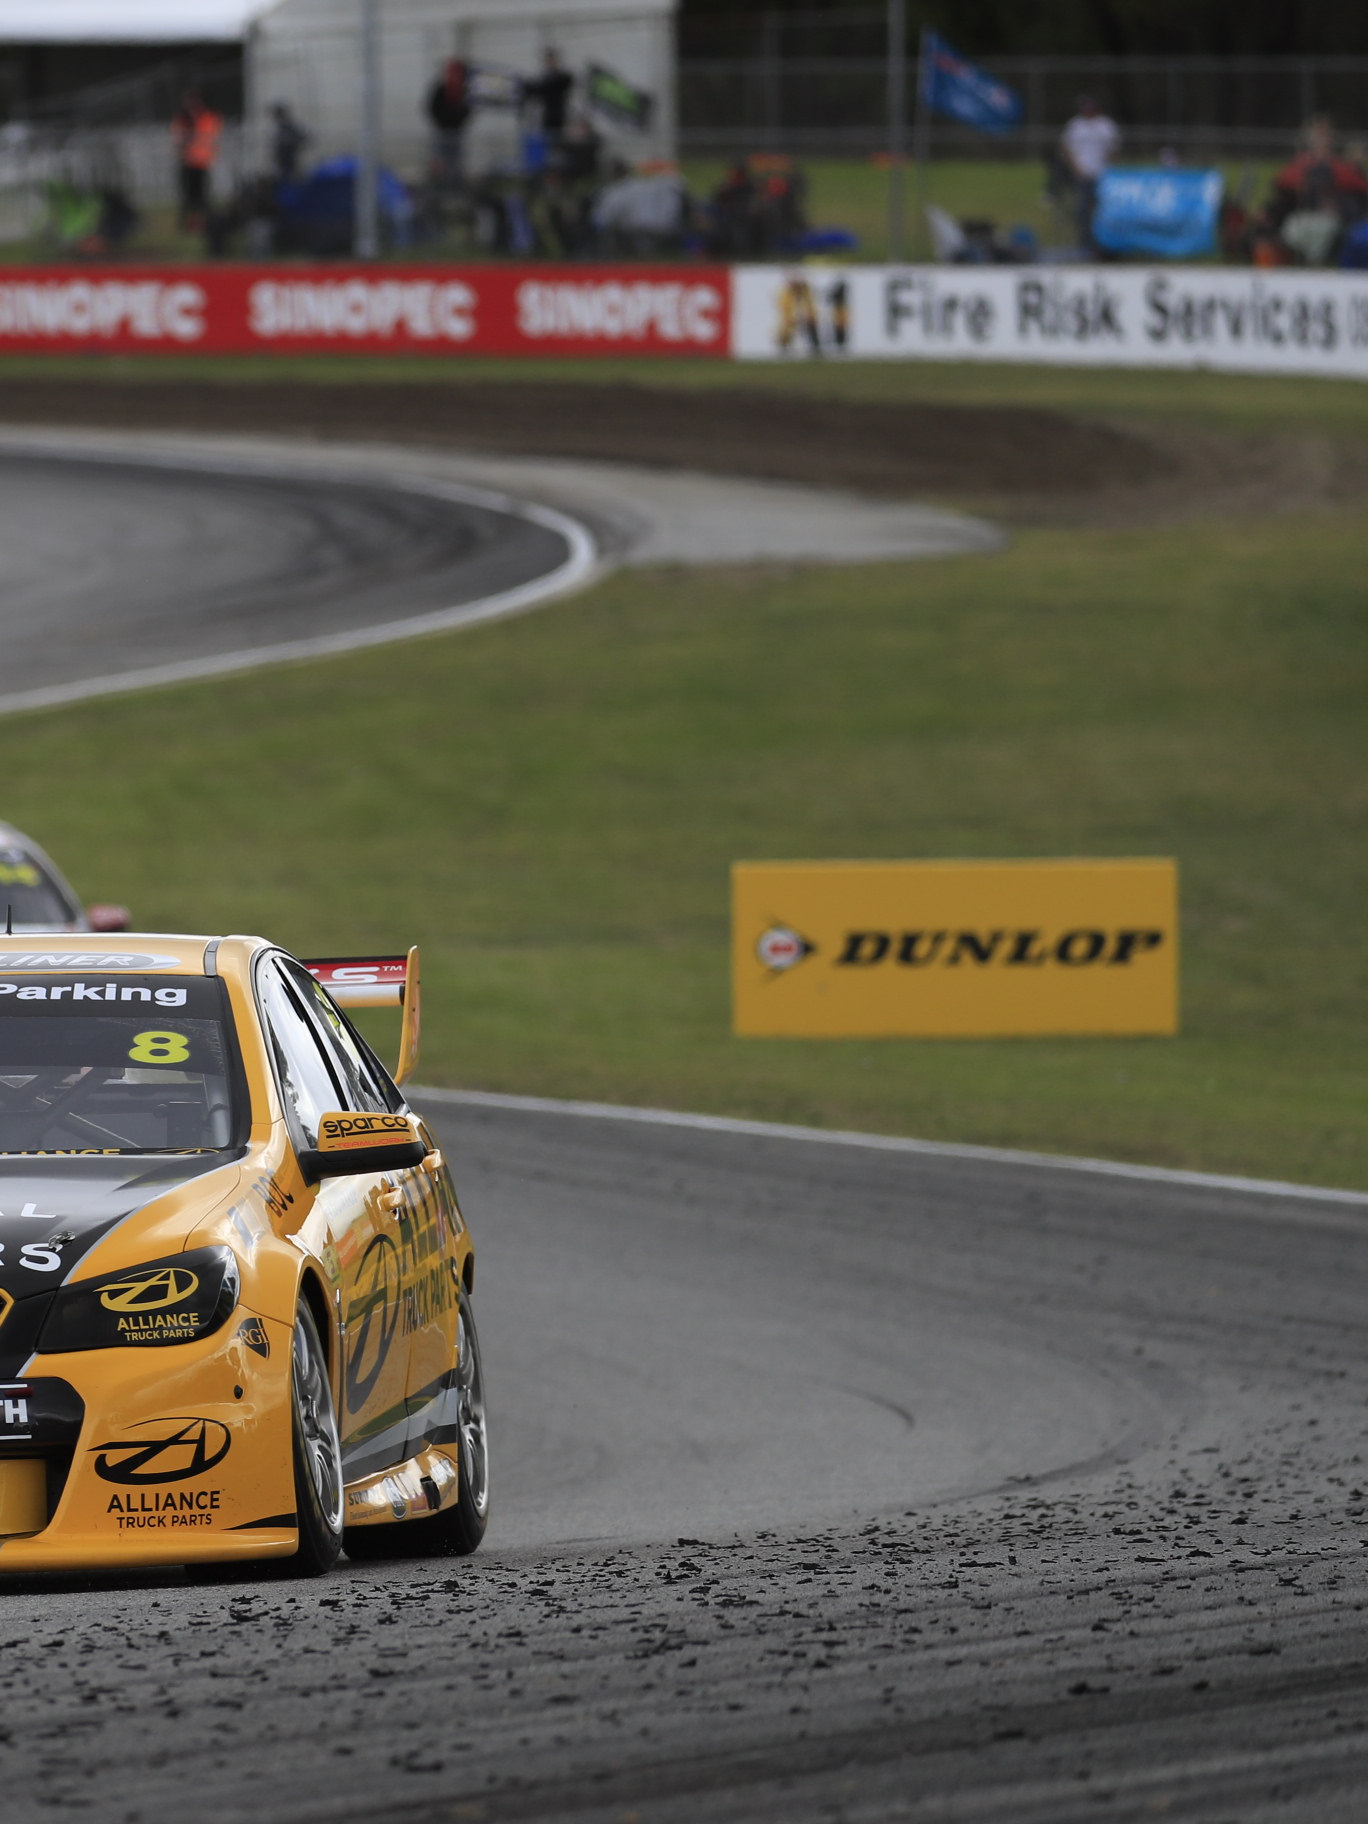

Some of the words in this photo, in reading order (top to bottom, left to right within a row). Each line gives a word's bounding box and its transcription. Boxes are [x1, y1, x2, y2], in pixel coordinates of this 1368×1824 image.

[248, 279, 476, 341] SINOPEC
[516, 280, 721, 343] SINOPEC
[883, 278, 998, 342] Fire
[1015, 281, 1123, 344] Risk
[1144, 279, 1338, 351] Services
[834, 929, 1165, 968] DUNLOP
[128, 1030, 191, 1064] 8
[323, 1116, 409, 1138] sparco
[117, 1312, 200, 1331] ALLIANCE
[124, 1330, 160, 1341] TRUCK
[162, 1328, 195, 1338] PARTS
[240, 1328, 269, 1345] RGI
[106, 1490, 221, 1513] ALLIANCE
[116, 1514, 166, 1529] TRUCK
[171, 1513, 213, 1526] PARTS
